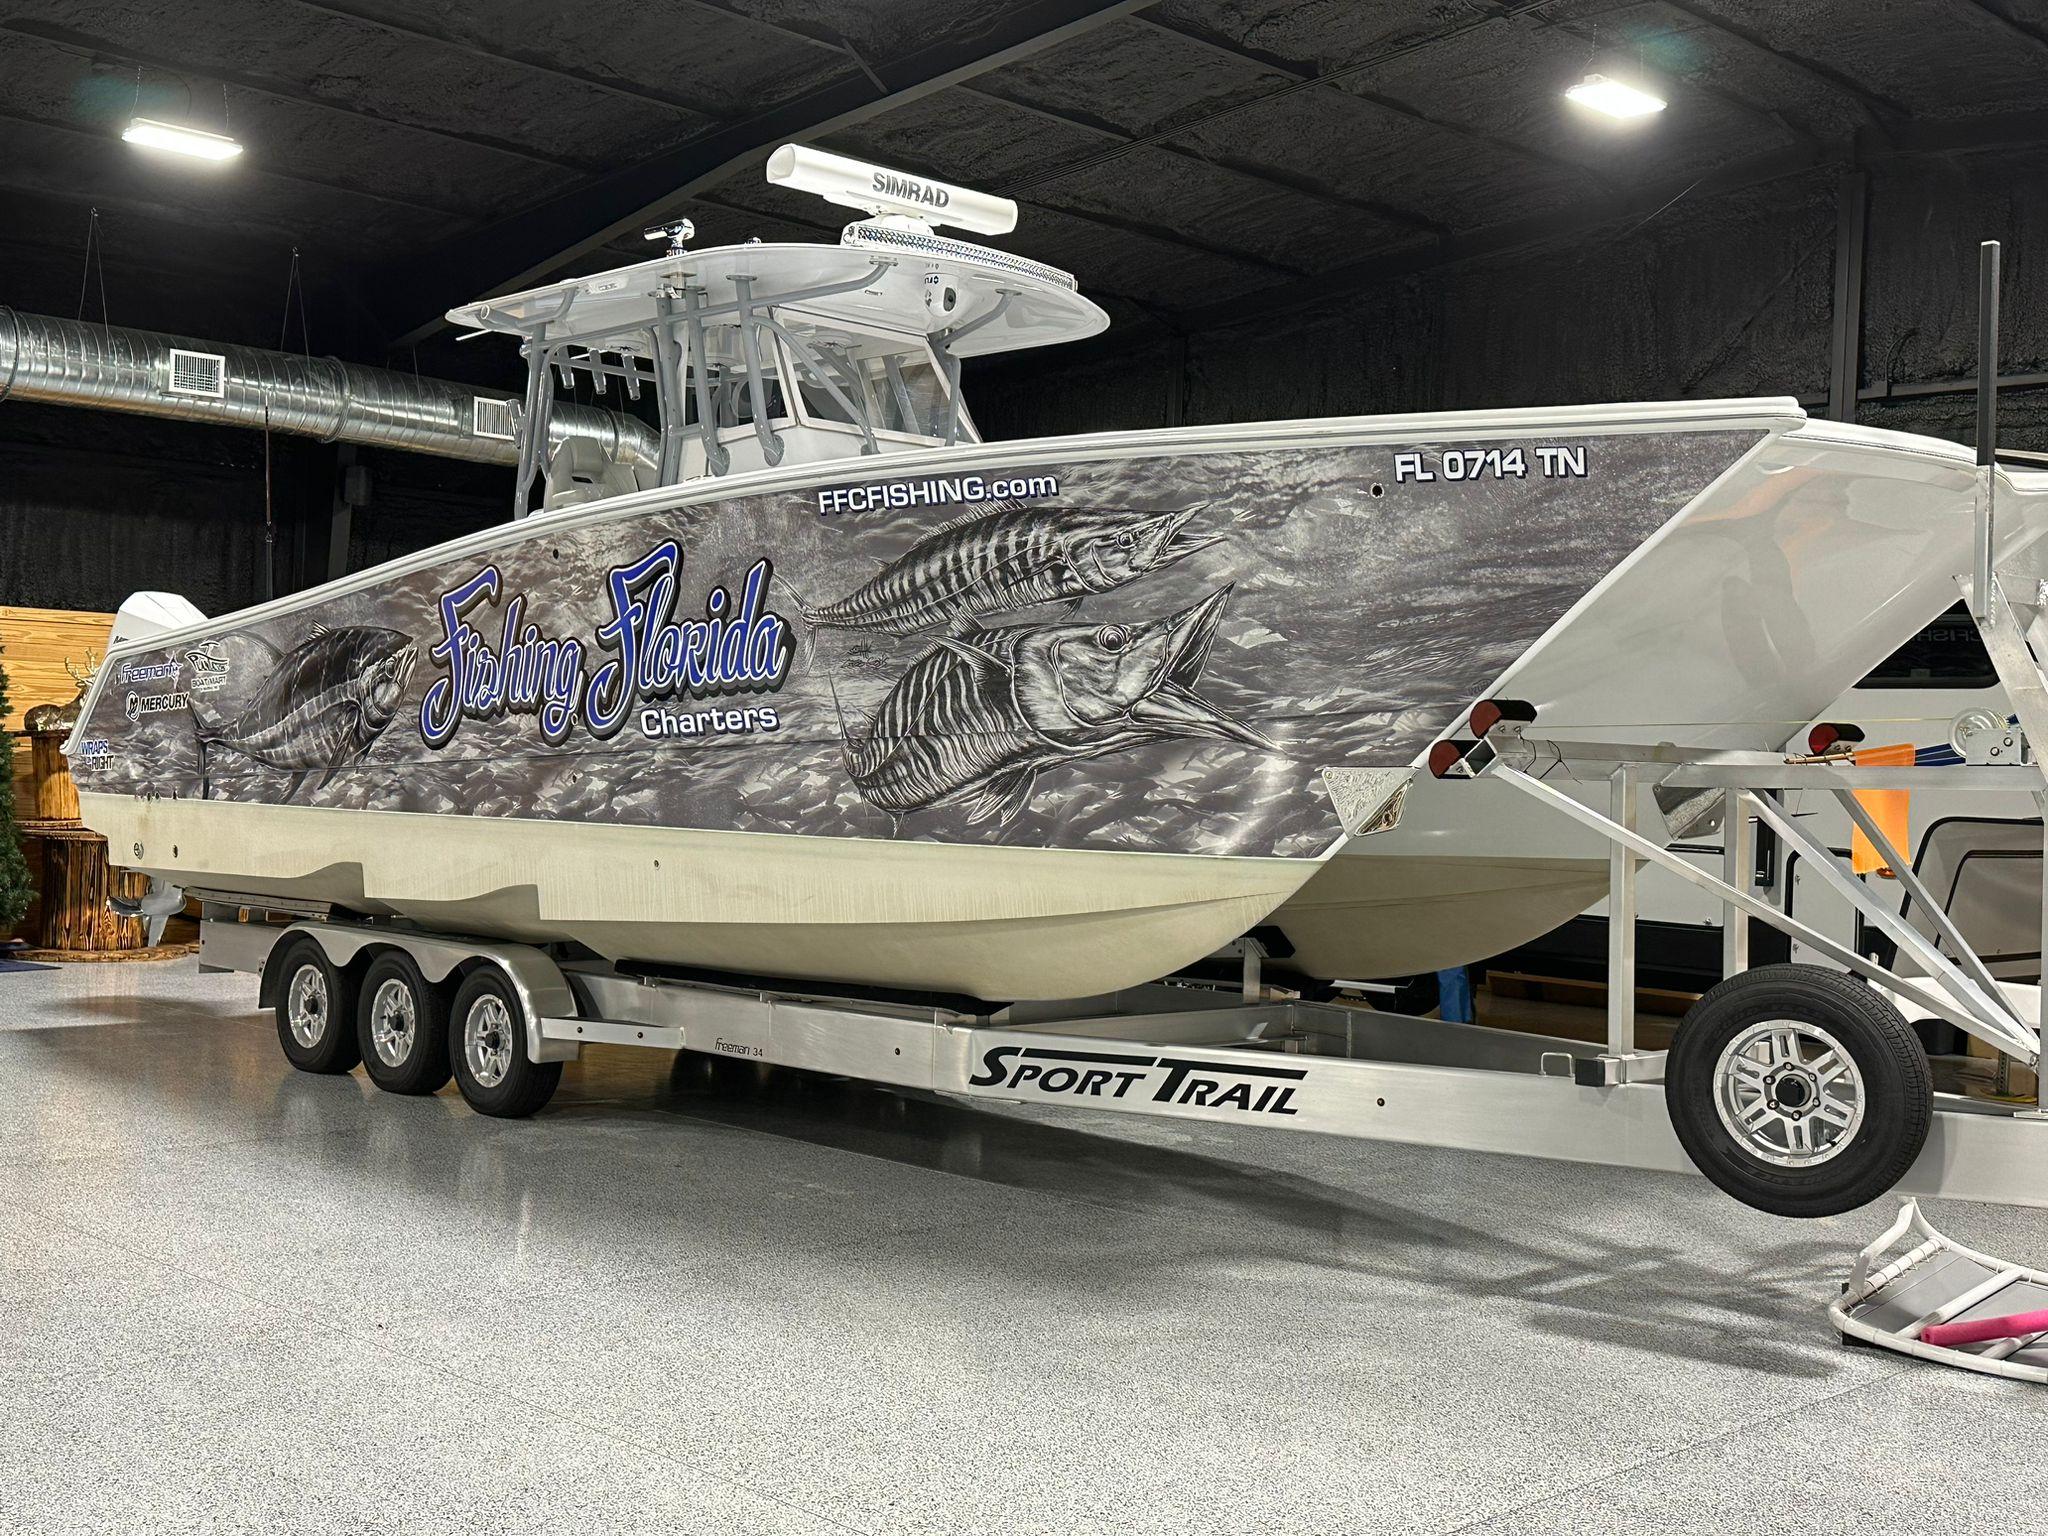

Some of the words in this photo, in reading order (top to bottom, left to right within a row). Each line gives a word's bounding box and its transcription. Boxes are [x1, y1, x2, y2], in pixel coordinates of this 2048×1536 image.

[872, 172, 950, 208] SIMRAD
[1394, 453, 1435, 482] FL
[1442, 448, 1527, 480] 0714
[1535, 446, 1587, 478] TN
[817, 475, 1059, 515] FFCFISHING.com
[418, 565, 584, 742] Fishing
[586, 540, 790, 732] Florida
[141, 693, 189, 712] MERCURY
[640, 706, 779, 738] Charters
[81, 739, 108, 755] WRAPS
[91, 755, 114, 769] RIGHT
[715, 1037, 750, 1055] freeman
[752, 1047, 763, 1057] 34
[969, 1047, 1157, 1099] SPORT
[1152, 1058, 1308, 1115] TRAIL
